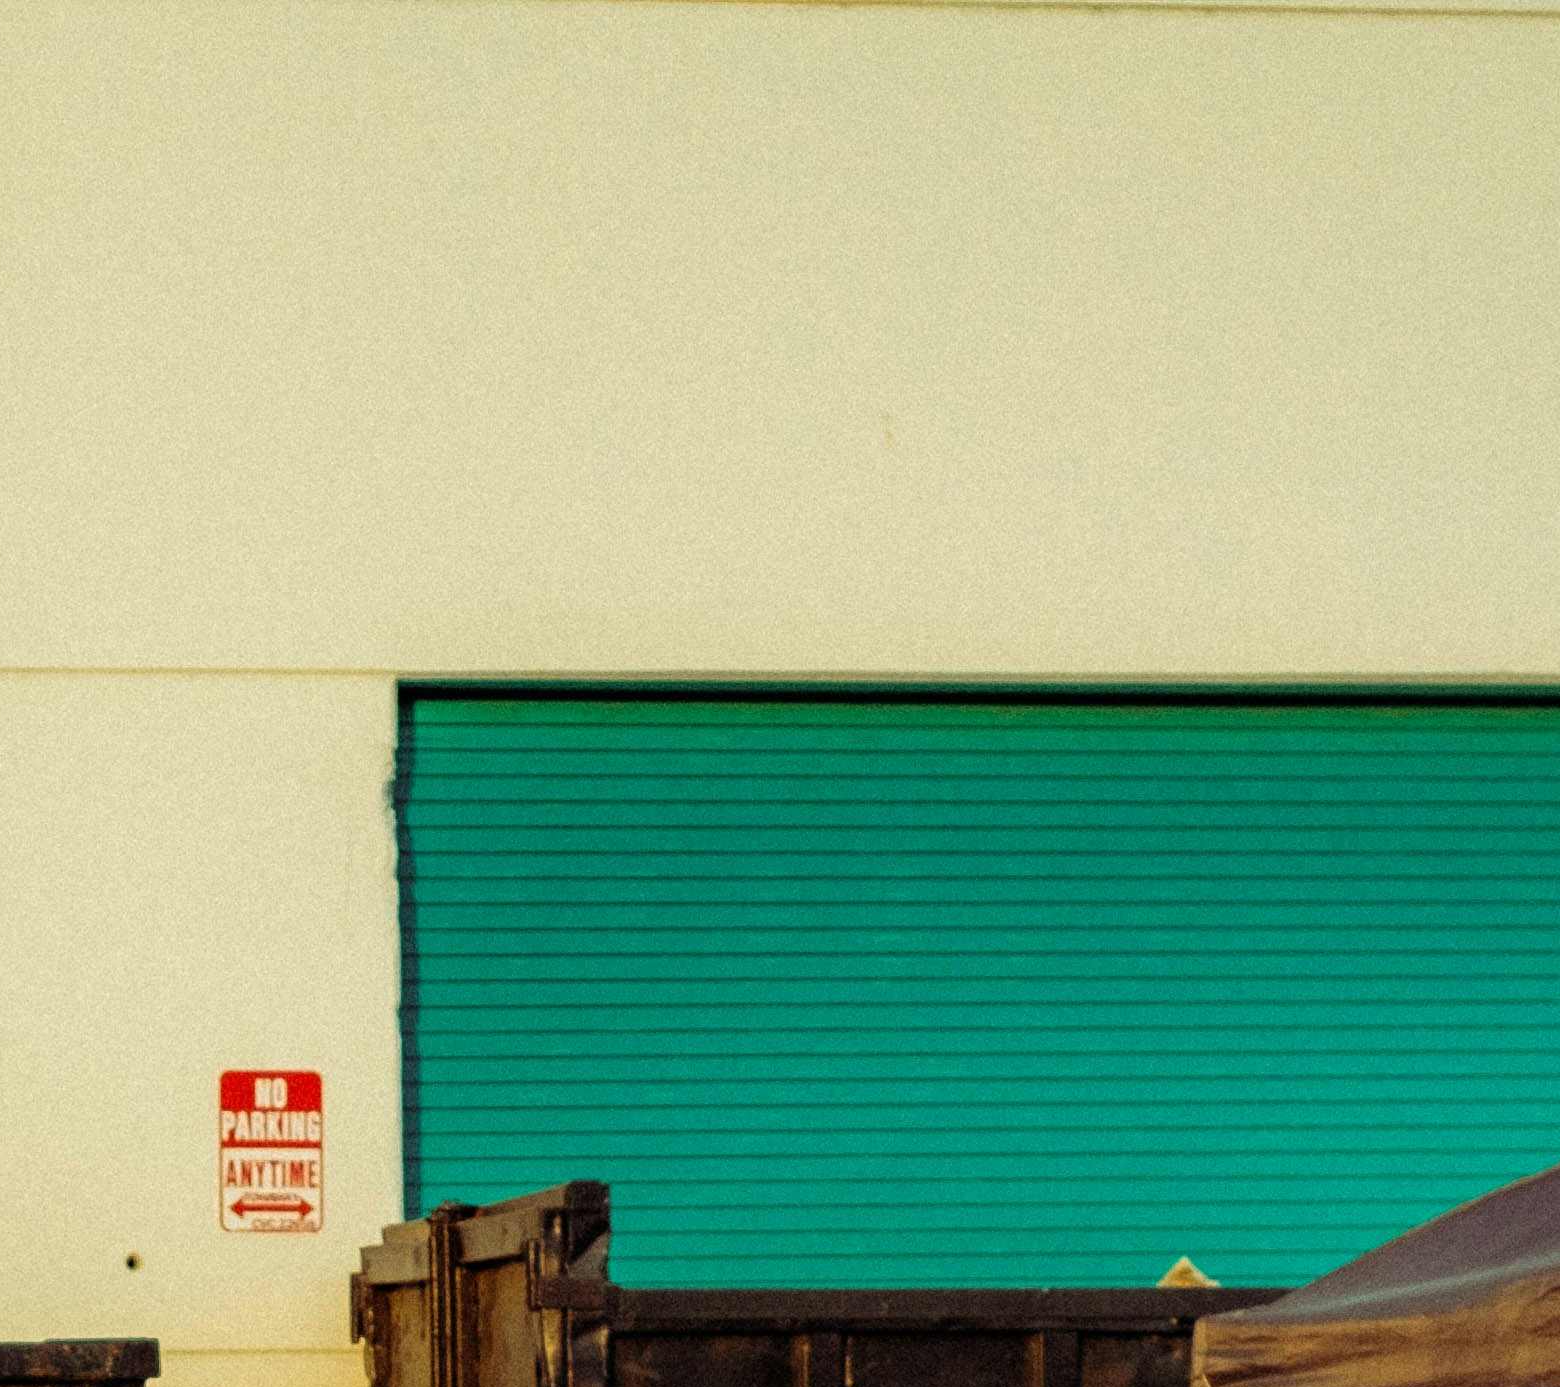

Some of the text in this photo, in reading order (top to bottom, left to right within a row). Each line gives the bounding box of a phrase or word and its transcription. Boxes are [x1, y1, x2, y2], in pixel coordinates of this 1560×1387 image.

[254, 1077, 288, 1109] NO
[221, 1110, 322, 1141] PARKING
[224, 1160, 321, 1188] ANYTIME
